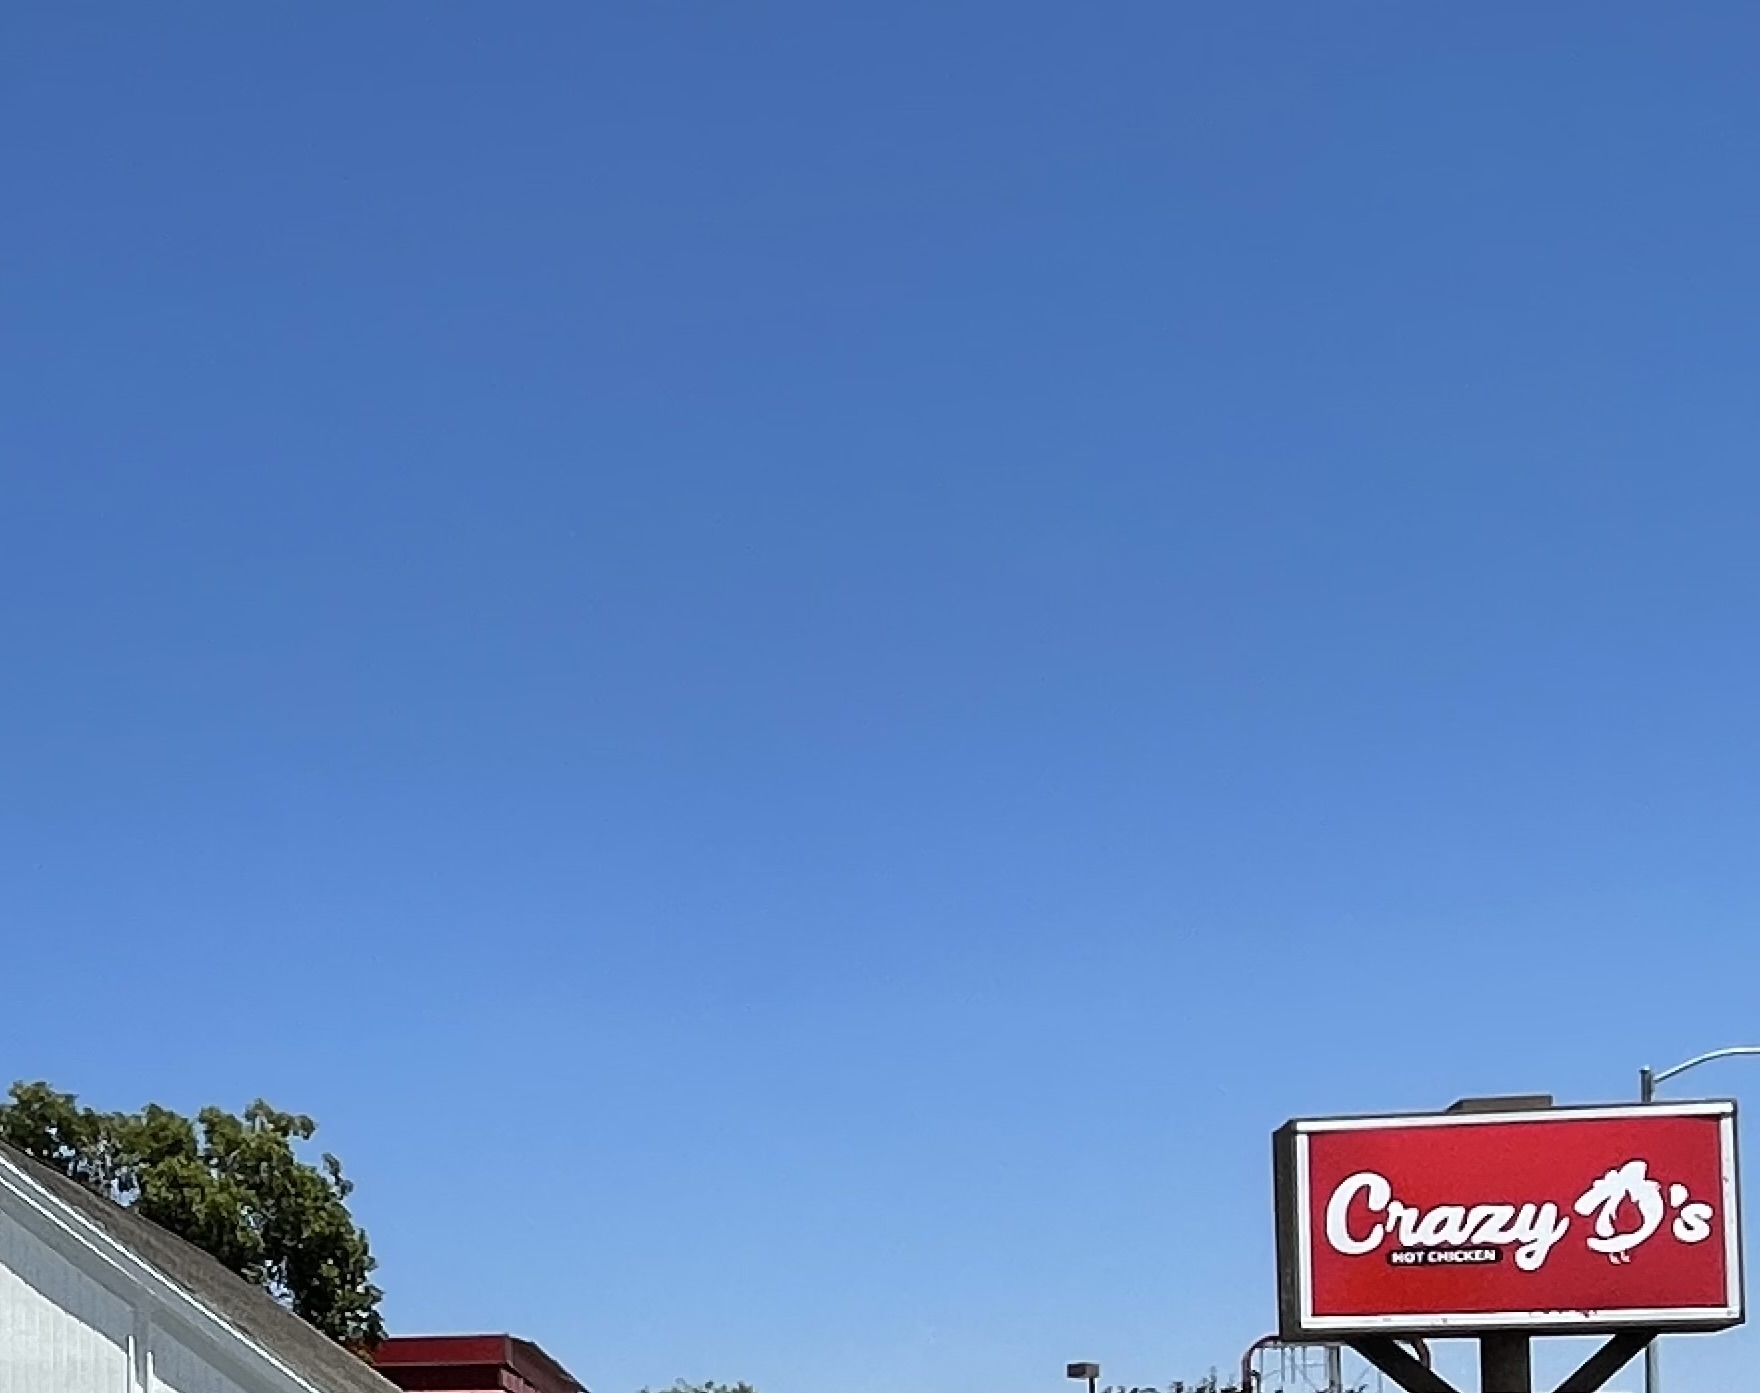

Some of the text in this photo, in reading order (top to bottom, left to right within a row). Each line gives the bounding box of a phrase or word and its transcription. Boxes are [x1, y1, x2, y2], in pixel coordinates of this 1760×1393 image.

[1326, 1171, 1570, 1271] Crazy
[1392, 1249, 1496, 1264] HOT CHICKEN
